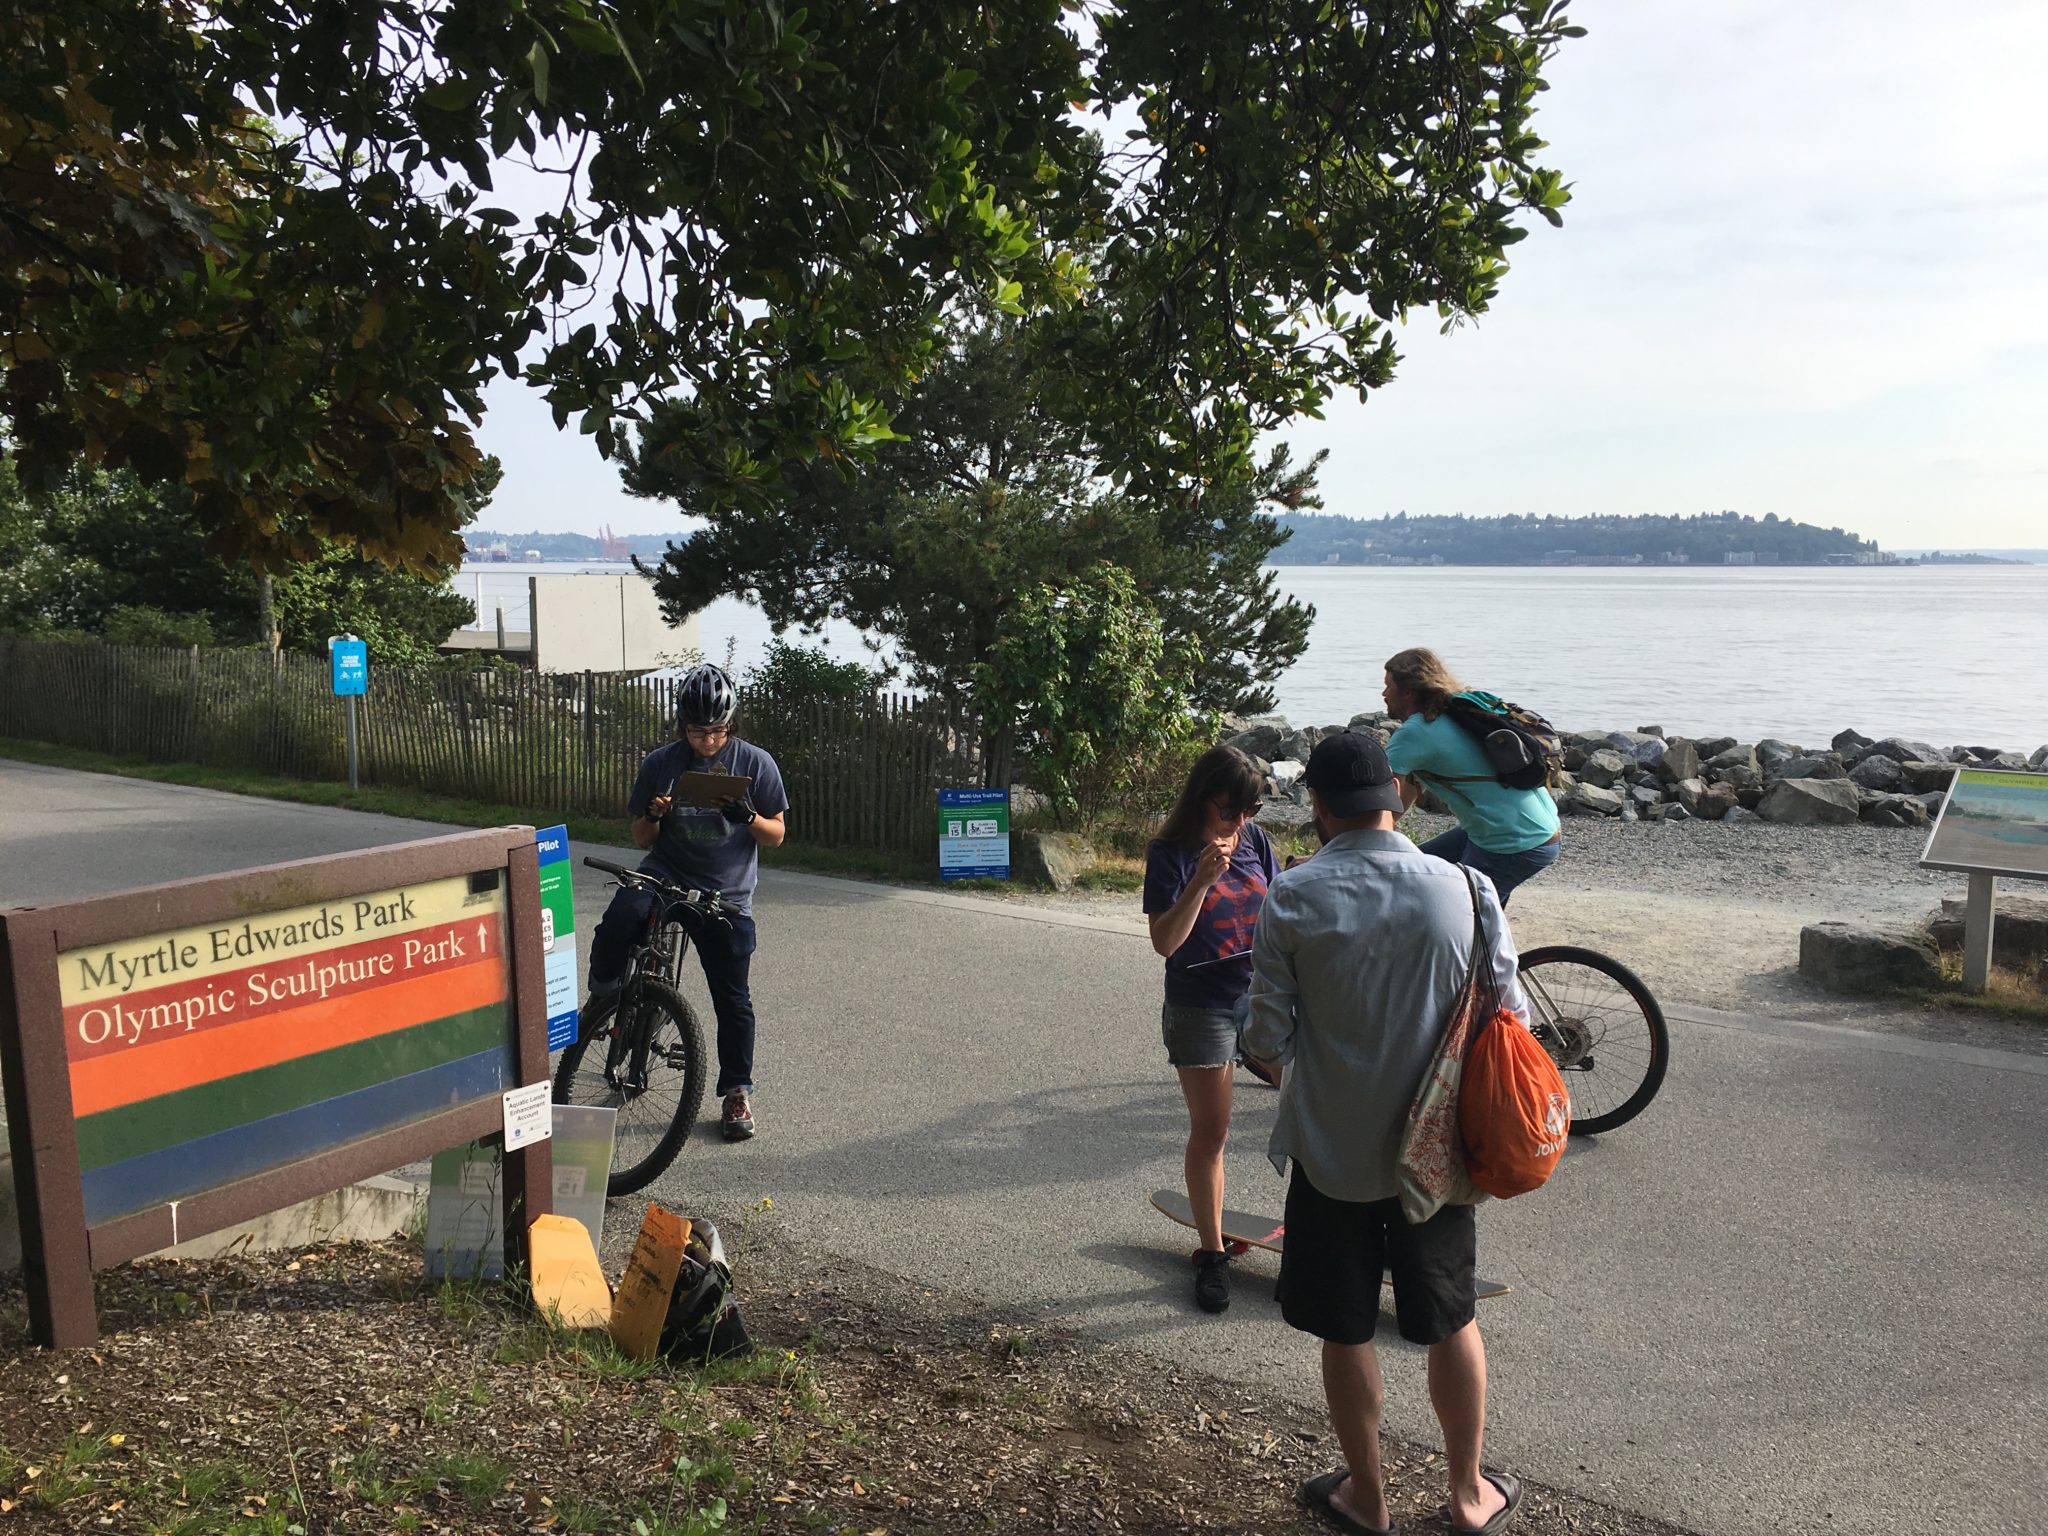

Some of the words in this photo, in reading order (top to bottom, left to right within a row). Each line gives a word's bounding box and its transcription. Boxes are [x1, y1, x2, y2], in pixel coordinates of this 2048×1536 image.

[538, 840, 559, 853] Pilot
[80, 936, 198, 991] Myrtle
[210, 906, 344, 962] Edwards
[353, 892, 417, 932] Park
[78, 987, 236, 1044] Olympic
[248, 954, 394, 1008] Sculpture
[403, 930, 466, 971] Park
[509, 1098, 529, 1109] Aquatic
[530, 1093, 546, 1102] Lands
[510, 1101, 546, 1116] Enhancement
[517, 1110, 539, 1121] Account
